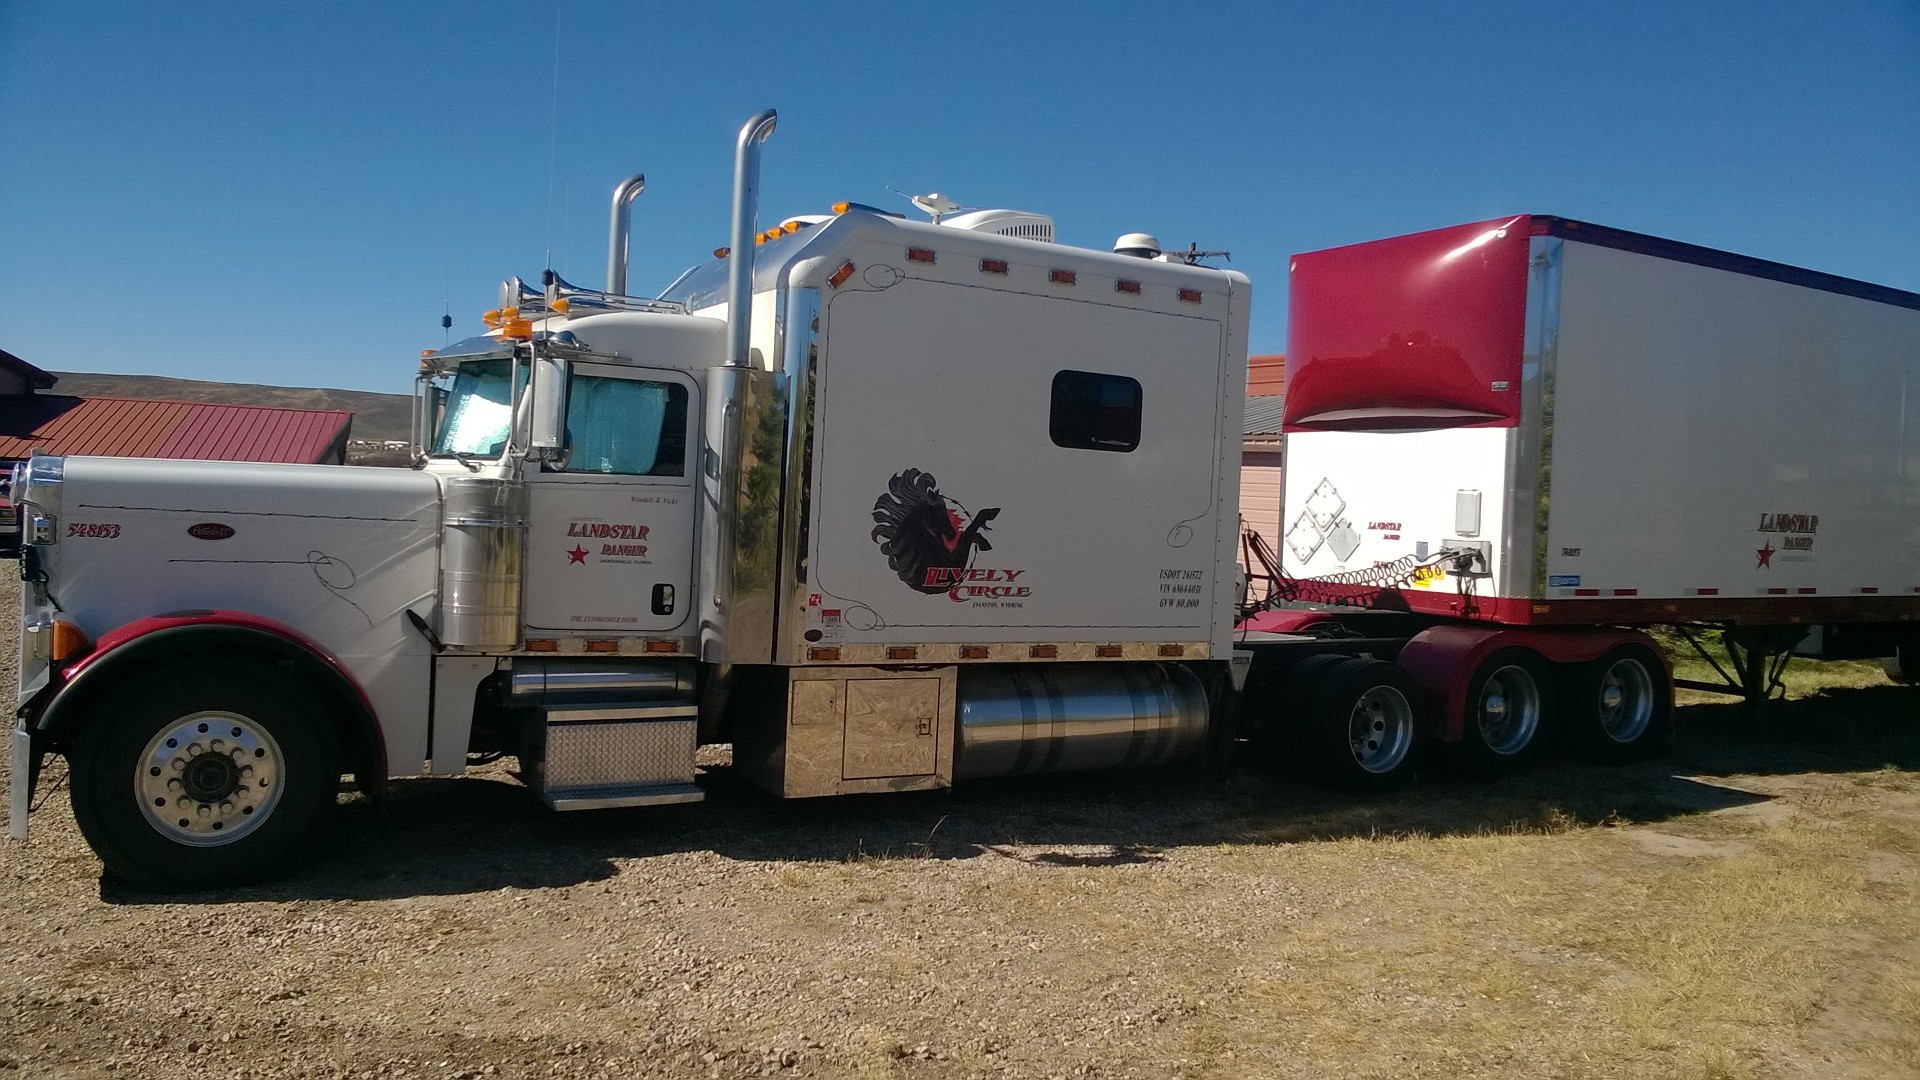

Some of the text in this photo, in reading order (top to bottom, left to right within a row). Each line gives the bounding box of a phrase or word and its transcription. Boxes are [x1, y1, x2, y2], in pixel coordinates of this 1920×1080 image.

[67, 523, 121, 538] 548153
[1368, 522, 1402, 531] LANDSTAR
[1758, 513, 1819, 535] LANDSTAR
[567, 522, 650, 541] LANDSTAR
[601, 544, 648, 557] RANGER
[922, 567, 1026, 587] LIVELY
[1160, 569, 1181, 579] USDOT
[949, 585, 1033, 602] CIRCLE
[1160, 584, 1171, 593] VIN
[1160, 598, 1175, 608] GVW
